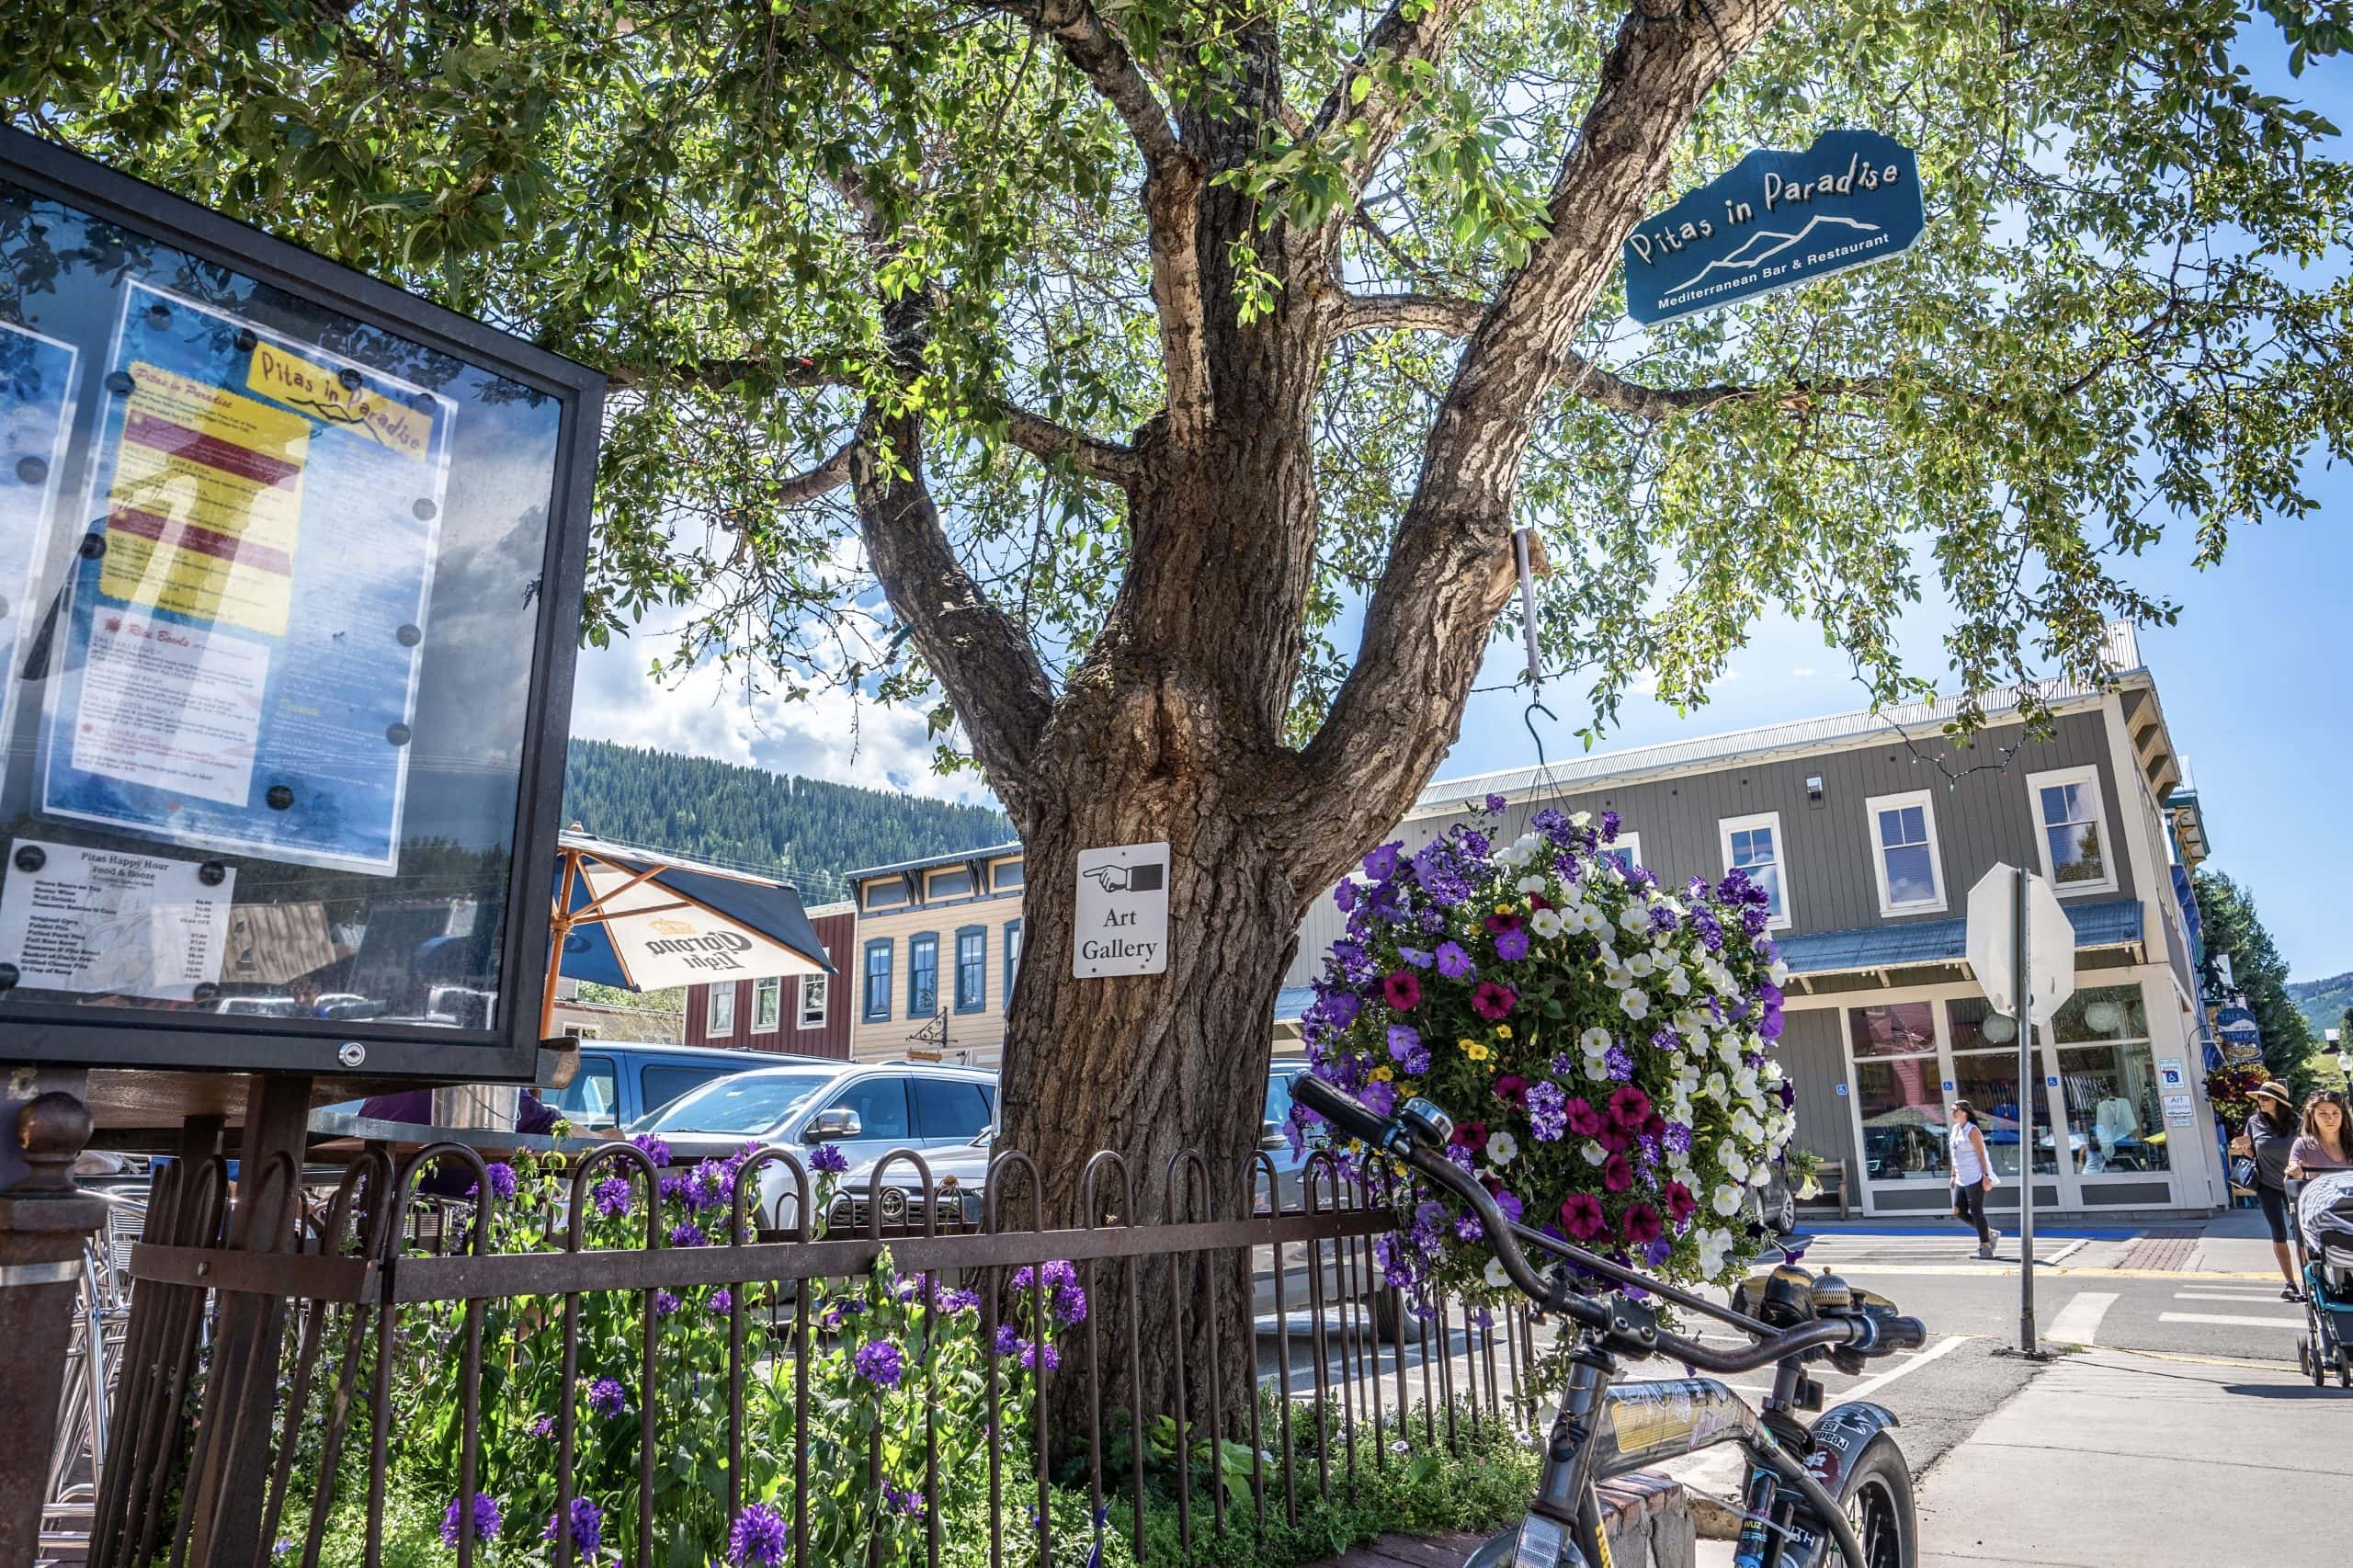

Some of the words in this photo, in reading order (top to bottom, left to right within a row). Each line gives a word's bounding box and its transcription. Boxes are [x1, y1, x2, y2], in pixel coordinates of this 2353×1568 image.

[1629, 215, 1715, 267] Pitas
[1724, 199, 1754, 226] in
[1764, 152, 1900, 212] Paradise
[1657, 272, 1758, 310] Mediterranean
[1761, 263, 1788, 279] Bar
[1791, 258, 1802, 270] &
[1807, 233, 1890, 265] Restaurant
[261, 351, 313, 392] Pitas
[324, 380, 339, 403] in
[347, 386, 421, 450] Paradise
[81, 852, 107, 863] Pitas
[109, 855, 142, 869] Happy
[144, 860, 170, 871] Hour
[92, 866, 117, 876] Food
[127, 869, 156, 881] Booze
[1103, 908, 1137, 927] Art
[1082, 938, 1158, 962] Gallery
